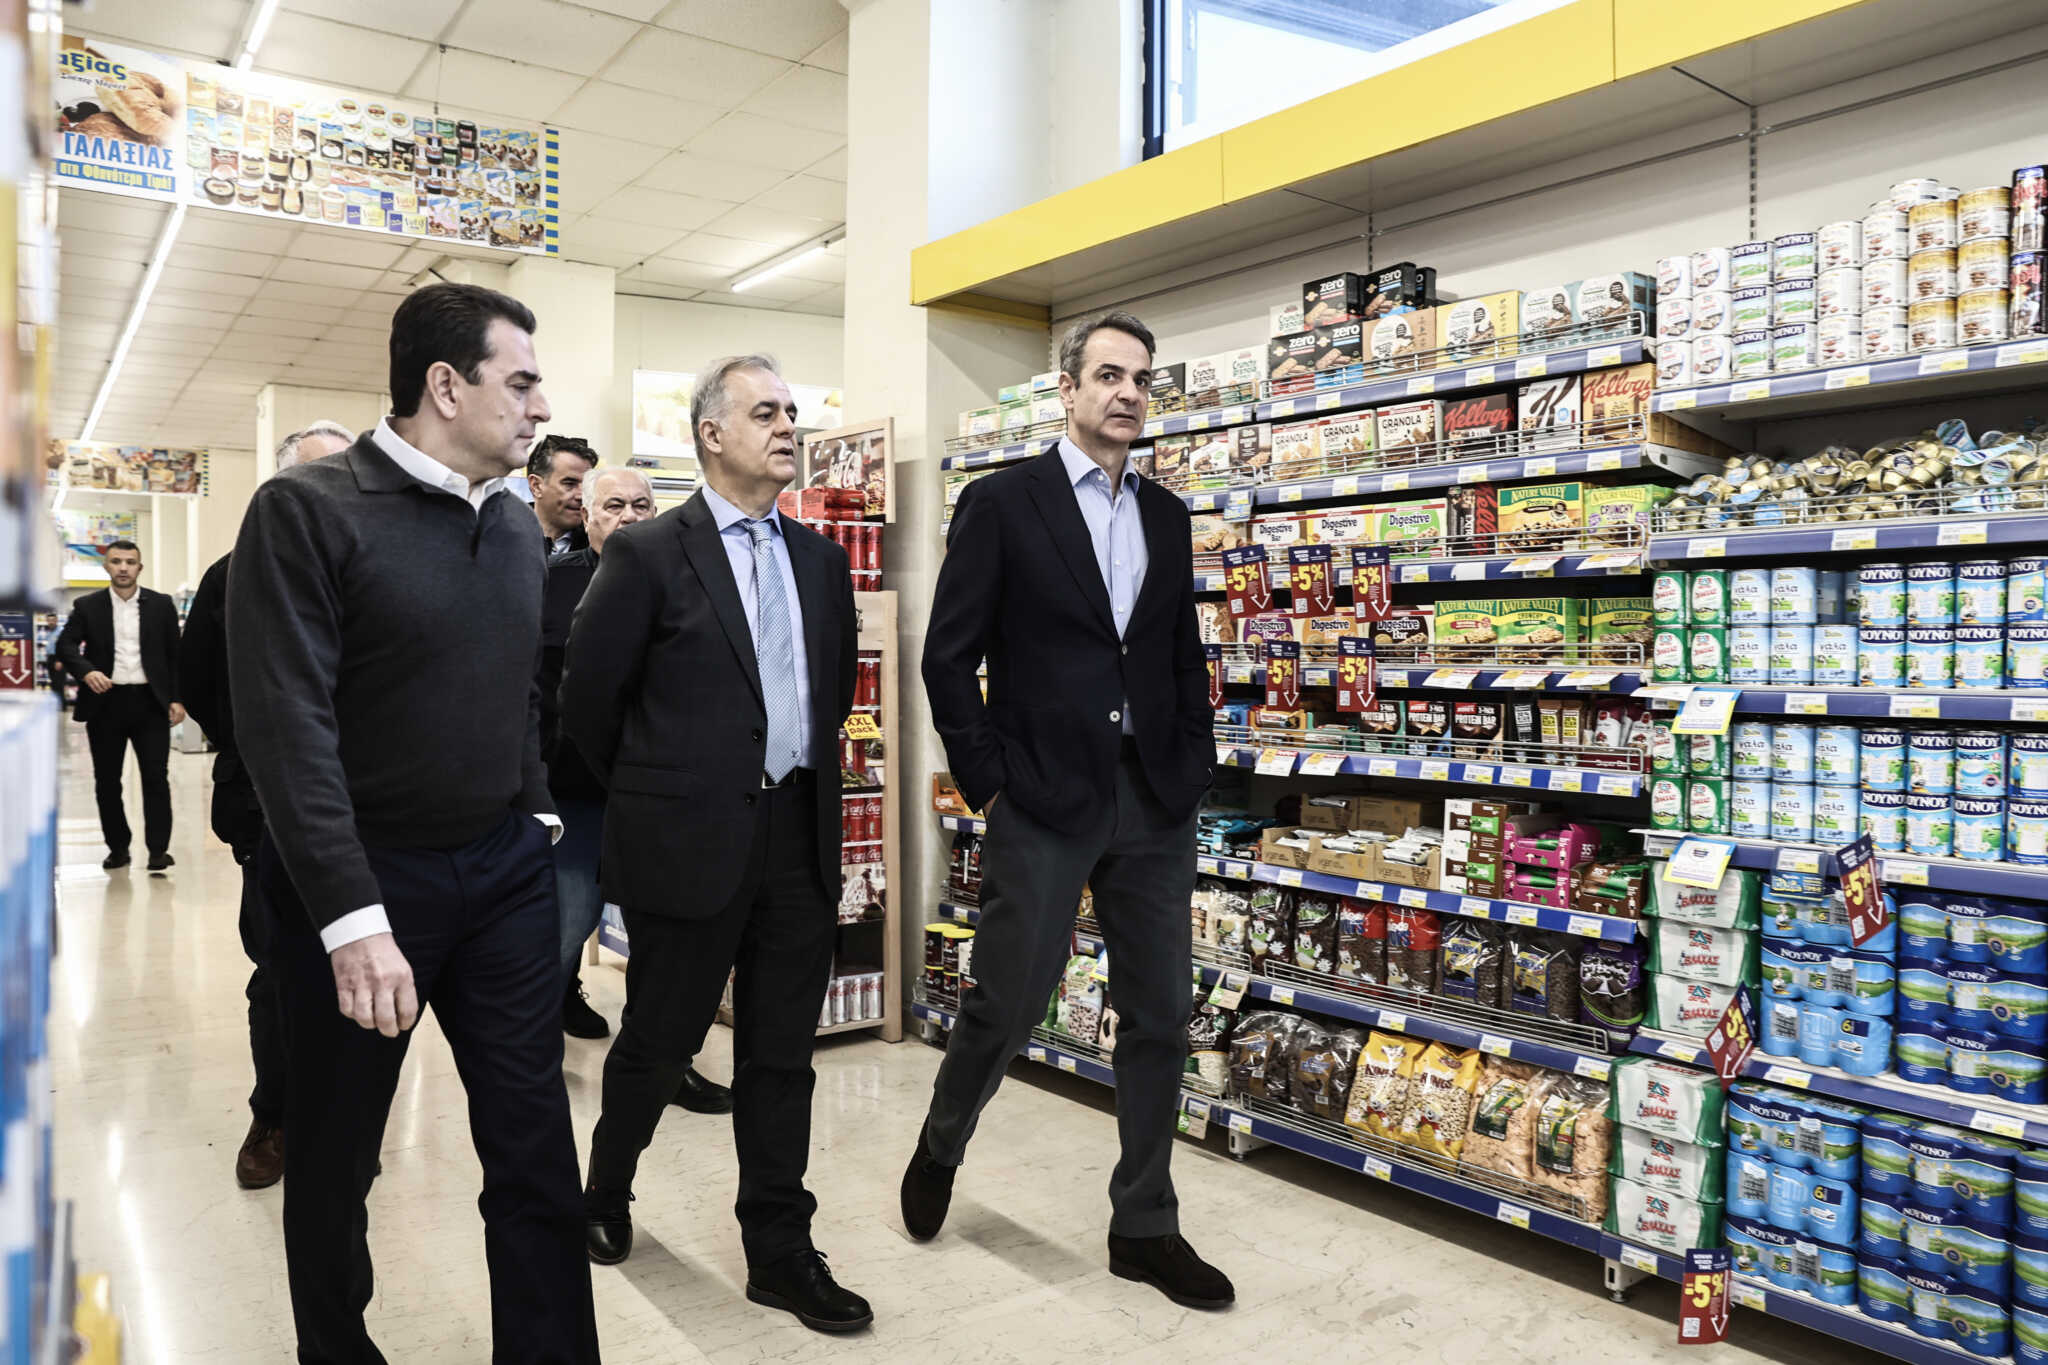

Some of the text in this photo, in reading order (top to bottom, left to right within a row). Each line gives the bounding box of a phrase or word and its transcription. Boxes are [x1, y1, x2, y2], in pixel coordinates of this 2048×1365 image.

[64, 132, 174, 171] ΓΑΛΑΞΙΑΣ
[1379, 269, 1402, 284] zero
[1320, 278, 1345, 292] zero
[1332, 324, 1360, 338] zero
[1289, 335, 1315, 348] zero
[1321, 518, 1358, 530] Digestive
[1389, 512, 1430, 527] Digestive
[1259, 524, 1293, 536] Digestive
[1250, 618, 1287, 631] Digestive
[1311, 618, 1350, 630] Digestive
[1377, 618, 1420, 630] Digestive
[847, 716, 871, 727] XXL
[849, 726, 875, 735] pack
[1780, 948, 1823, 962] NOYNOY
[1749, 1103, 1792, 1121] NOYNOY
[1746, 1225, 1787, 1244] NOYNOY
